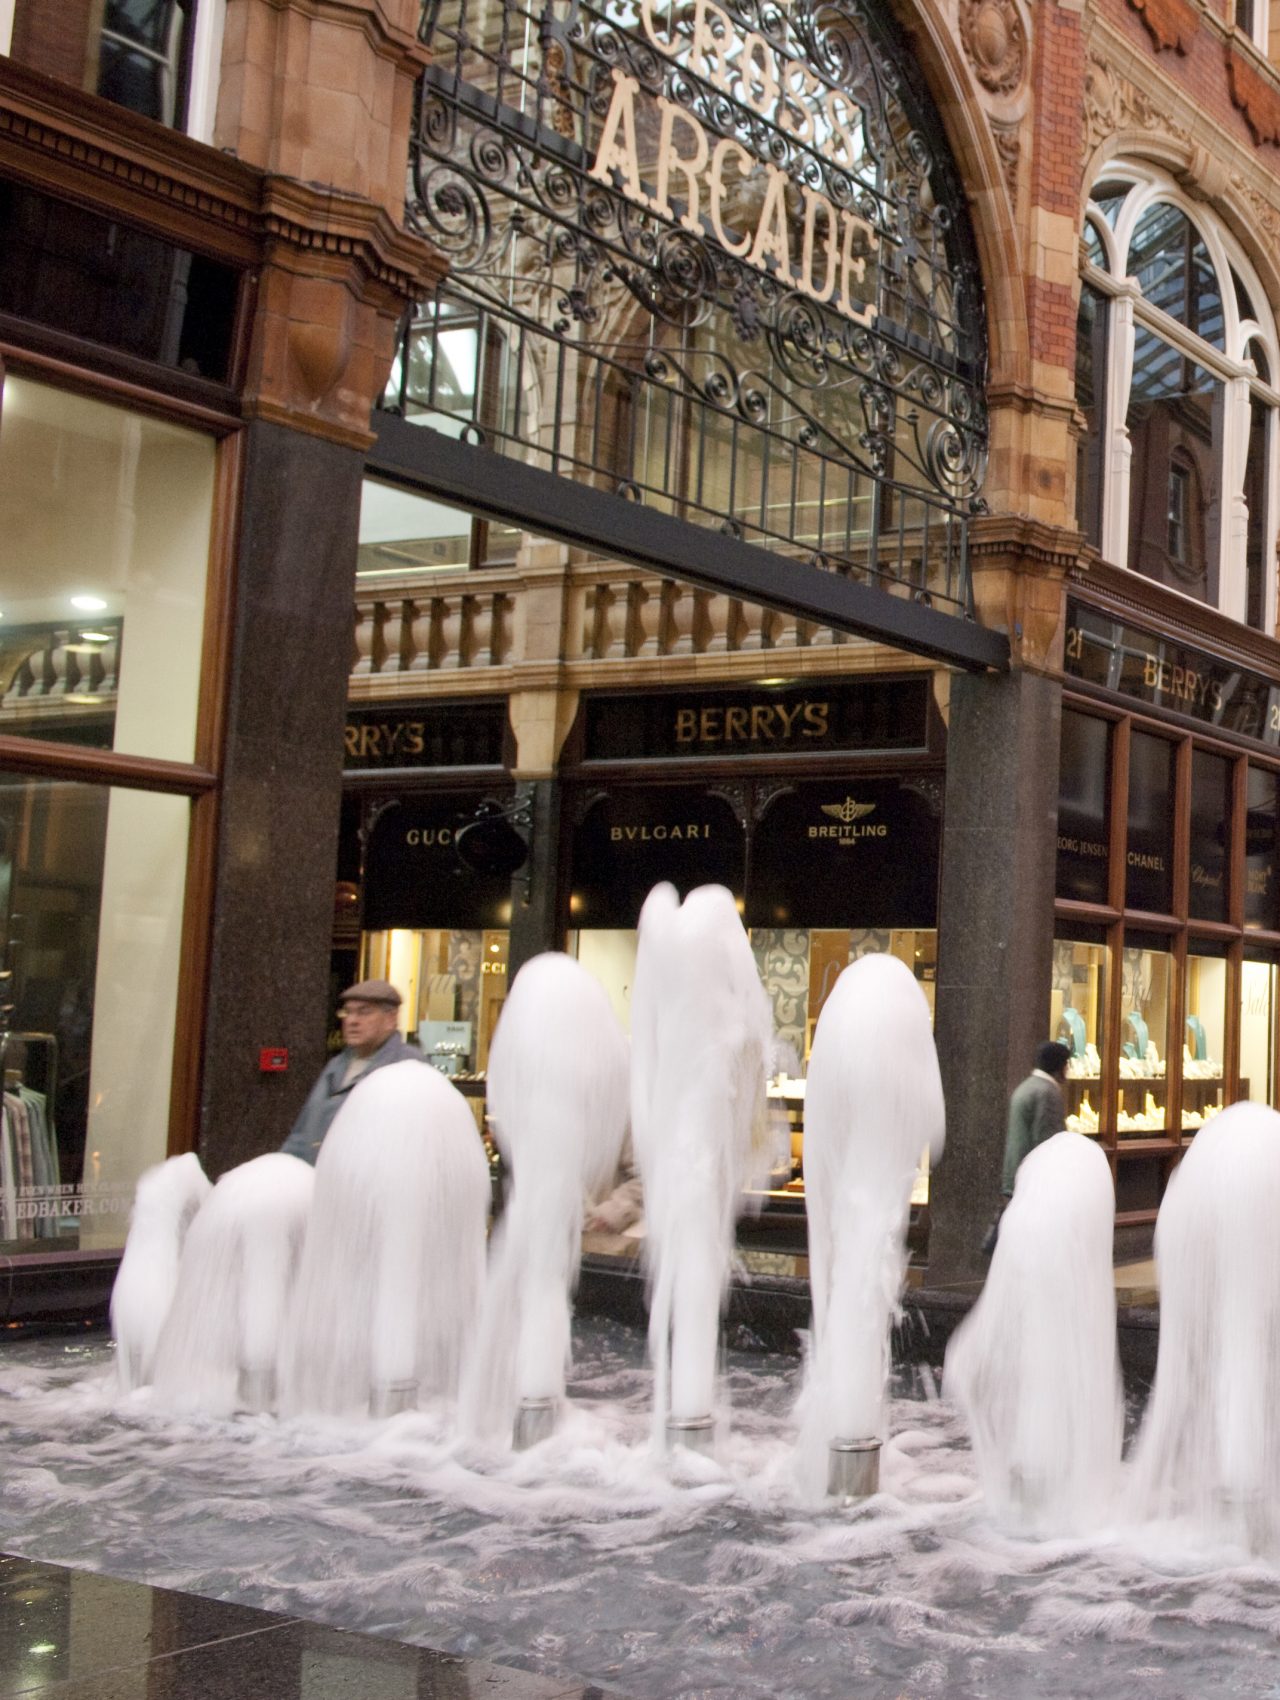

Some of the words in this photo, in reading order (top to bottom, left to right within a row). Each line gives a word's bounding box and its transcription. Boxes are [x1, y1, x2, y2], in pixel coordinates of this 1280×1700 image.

[587, 68, 881, 325] ARCADE
[1067, 627, 1083, 660] 21
[406, 829, 451, 845] GUC
[610, 824, 710, 841] BVLGARI
[808, 825, 887, 837] BREITLING
[1058, 836, 1079, 852] EORG
[1127, 852, 1165, 872] CHANEL
